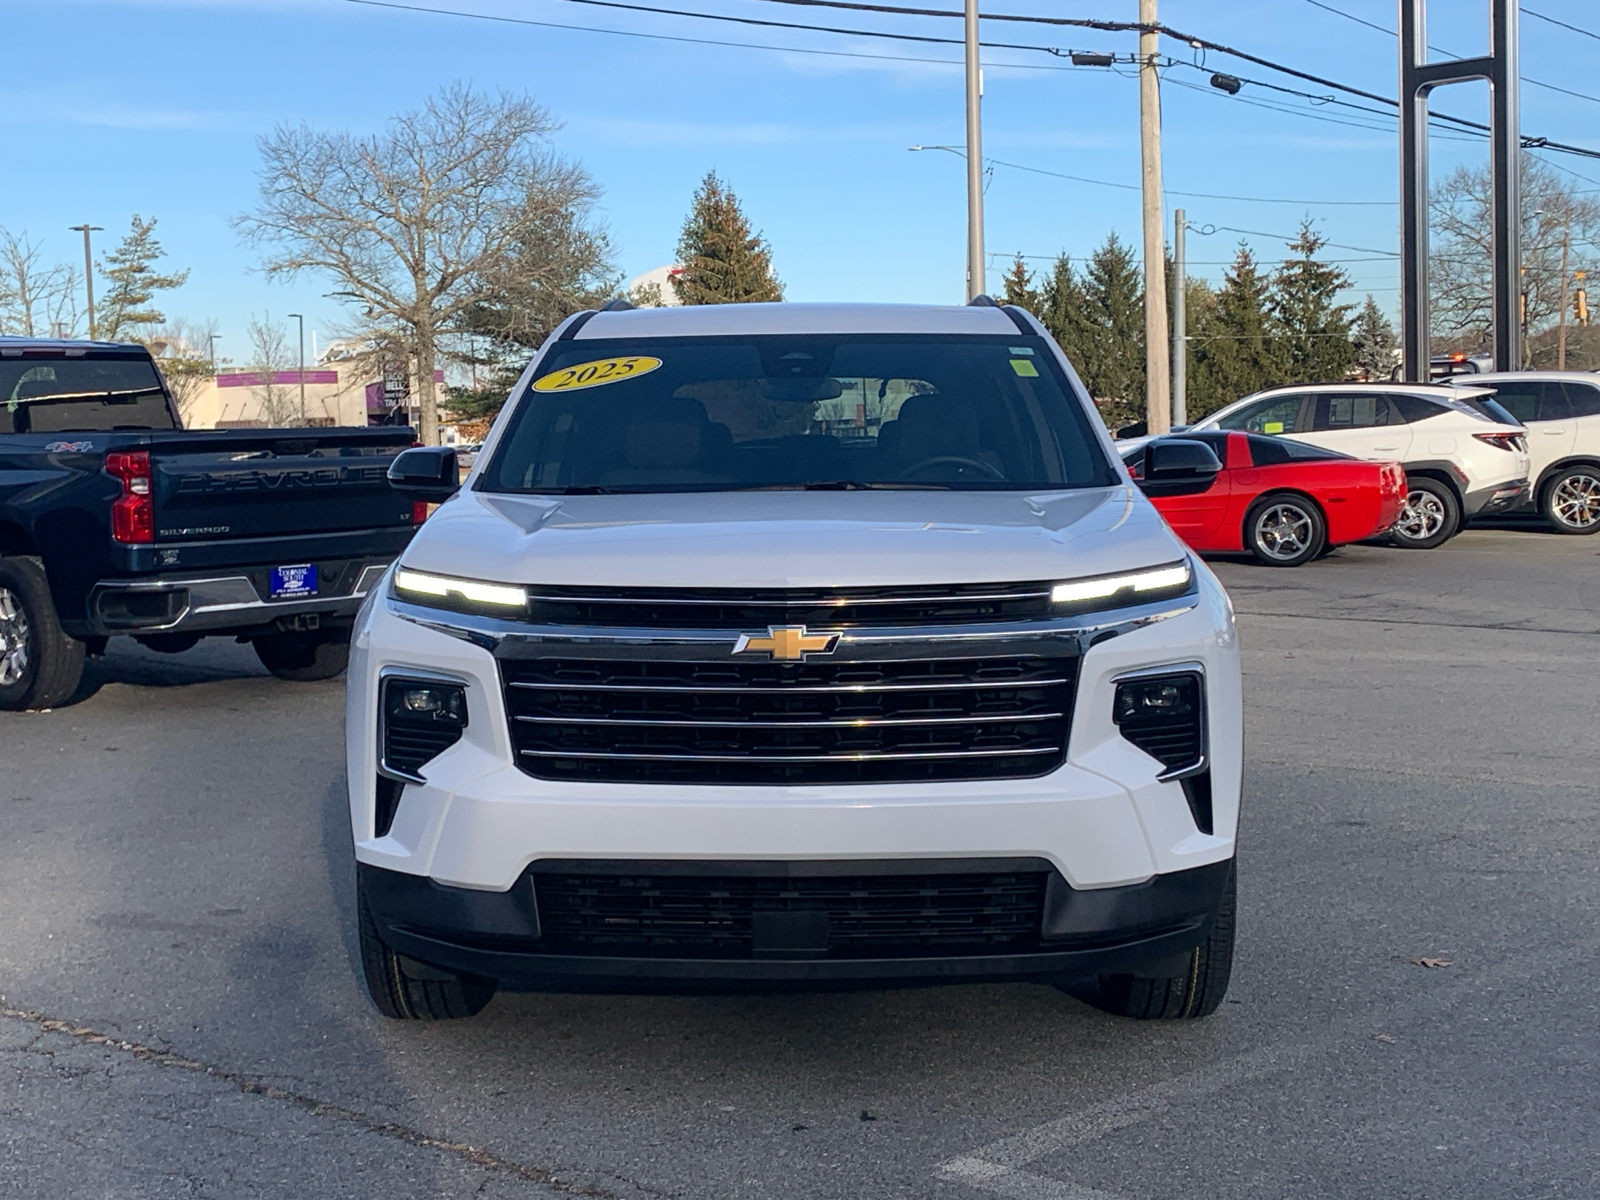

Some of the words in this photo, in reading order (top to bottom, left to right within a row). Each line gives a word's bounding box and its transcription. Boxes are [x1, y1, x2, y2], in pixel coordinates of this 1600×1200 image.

[553, 358, 640, 389] 2025
[385, 381, 404, 391] BELL
[177, 467, 384, 493] CHEVROLE
[160, 526, 230, 536] SILVERADO
